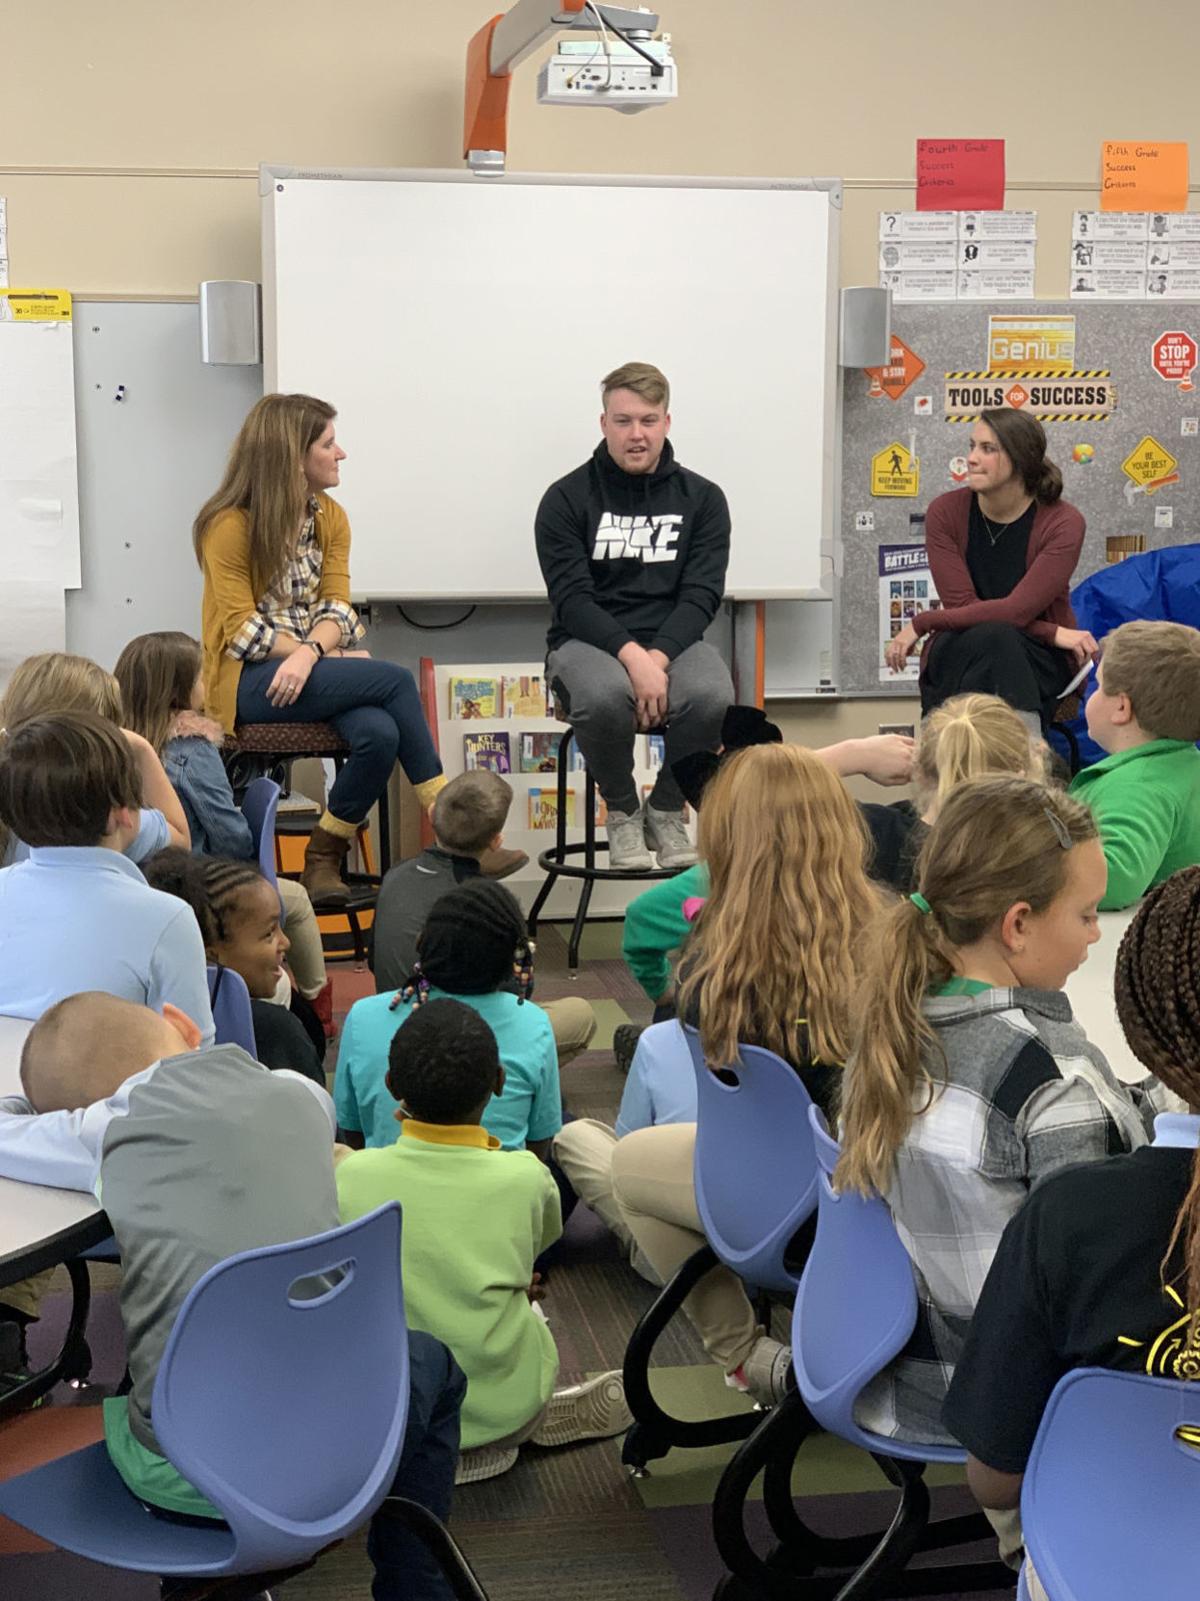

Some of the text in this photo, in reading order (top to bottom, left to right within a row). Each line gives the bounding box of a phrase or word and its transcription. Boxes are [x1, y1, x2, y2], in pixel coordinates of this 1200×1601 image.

[991, 336, 1074, 361] Genius
[1160, 345, 1190, 359] STOP
[949, 386, 1107, 407] TOOLS FOR SUCCESS
[1145, 452, 1153, 460] BE
[1132, 460, 1167, 470] YOUR BEST
[1142, 470, 1157, 479] SELF
[884, 553, 919, 569] BATTLE
[478, 735, 495, 745] KEY
